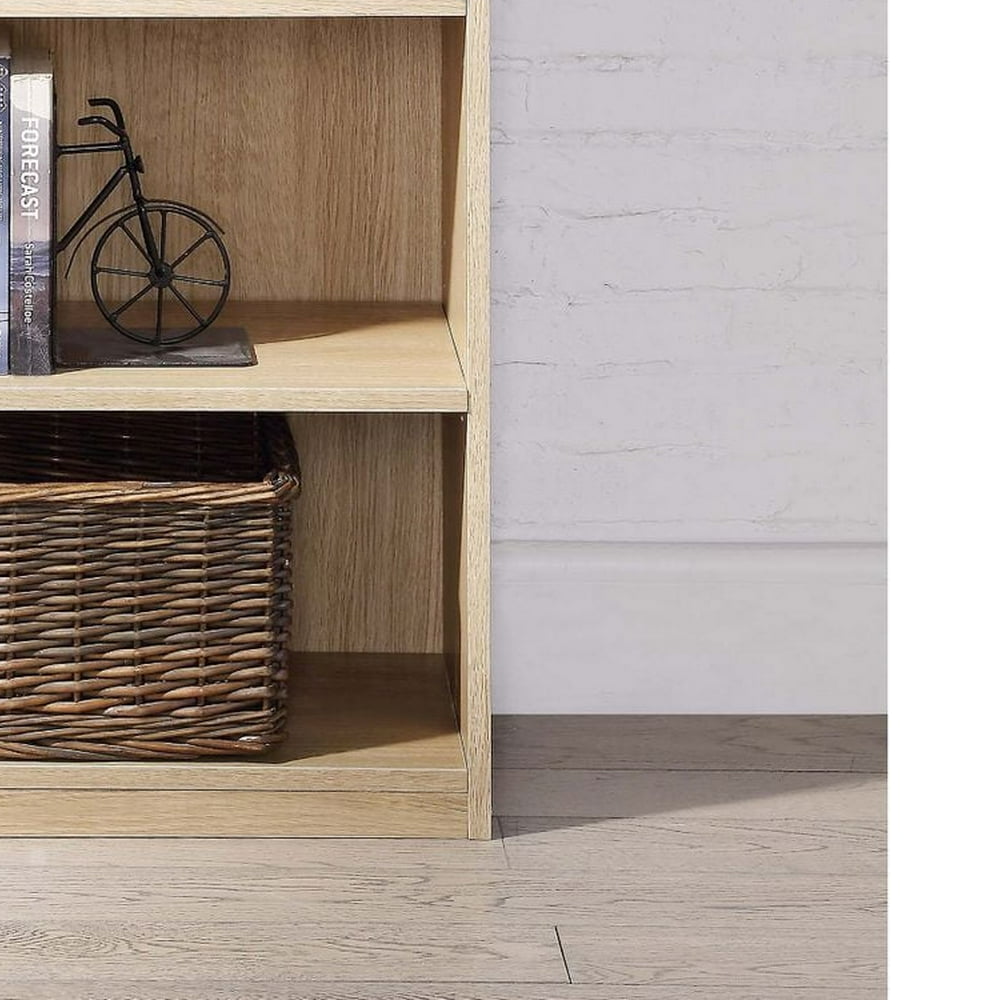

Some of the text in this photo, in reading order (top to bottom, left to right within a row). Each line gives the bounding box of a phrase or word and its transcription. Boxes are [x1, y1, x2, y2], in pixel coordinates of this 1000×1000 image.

[21, 117, 40, 220] FORECAST
[24, 243, 36, 324] Sarah Costelloe
